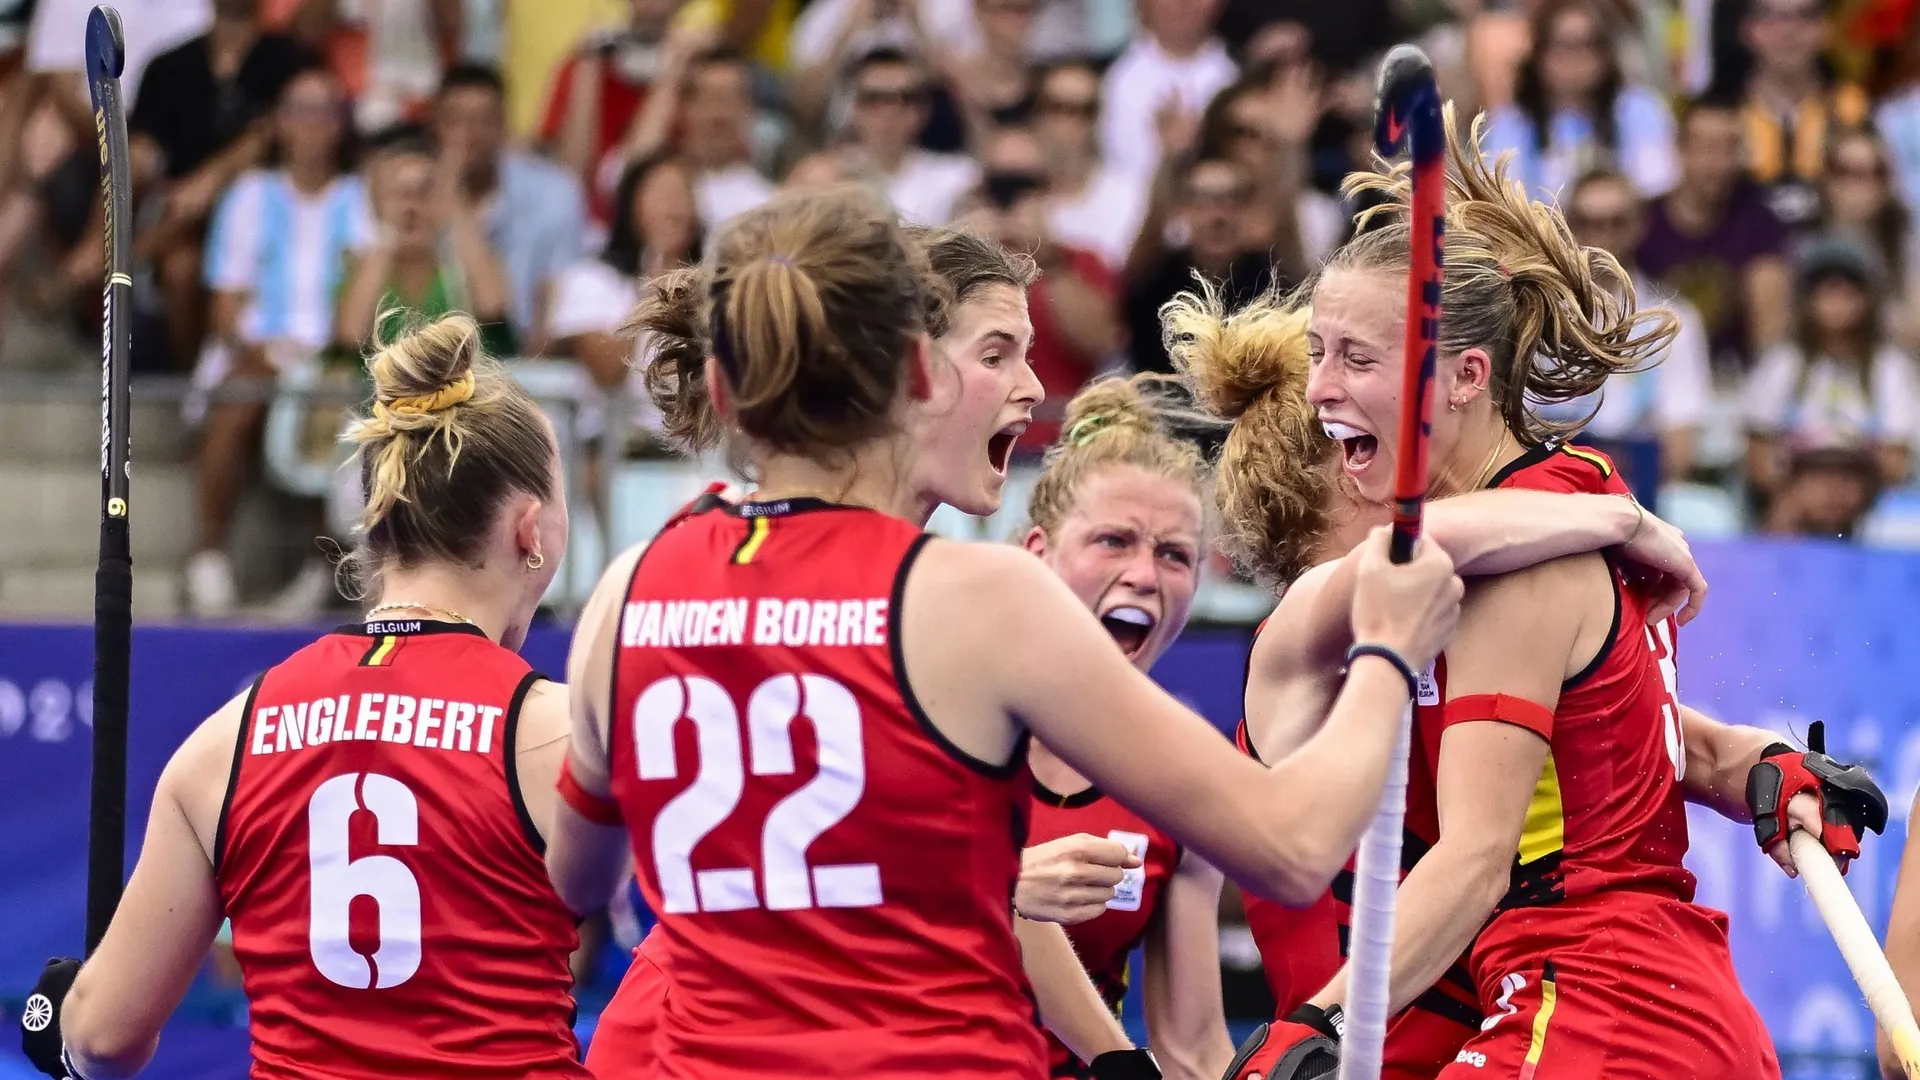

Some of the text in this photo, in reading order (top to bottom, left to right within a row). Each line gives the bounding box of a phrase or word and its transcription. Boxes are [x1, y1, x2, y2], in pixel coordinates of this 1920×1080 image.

[366, 621, 421, 635] BELGIUM
[622, 598, 889, 648] VANDEN BORRE
[250, 692, 502, 756] ENGLEBERT
[632, 672, 885, 915] 22
[308, 772, 422, 990] 6
